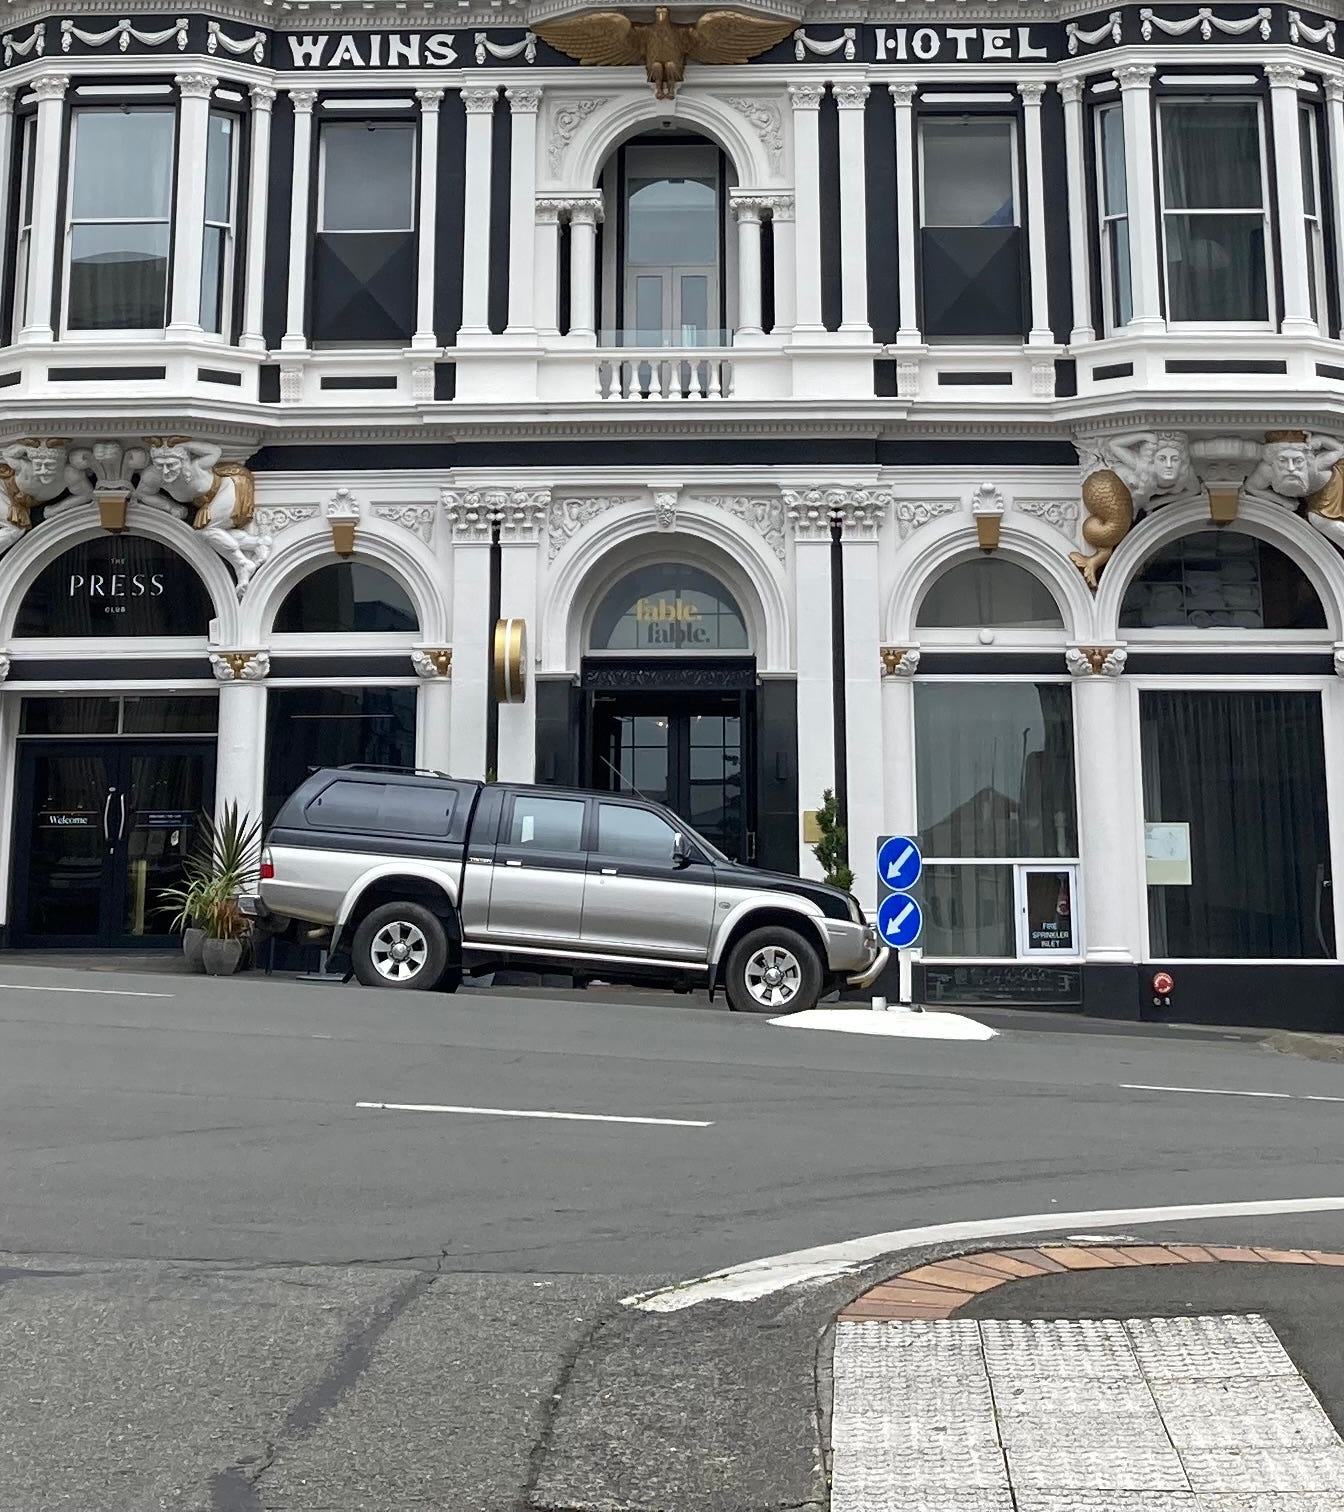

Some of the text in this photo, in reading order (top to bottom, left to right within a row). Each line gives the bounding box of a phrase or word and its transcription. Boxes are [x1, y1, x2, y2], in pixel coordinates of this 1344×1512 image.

[287, 28, 1047, 67] WAINS HOTEL
[69, 574, 164, 596] PRESS
[49, 815, 88, 825] Welcome
